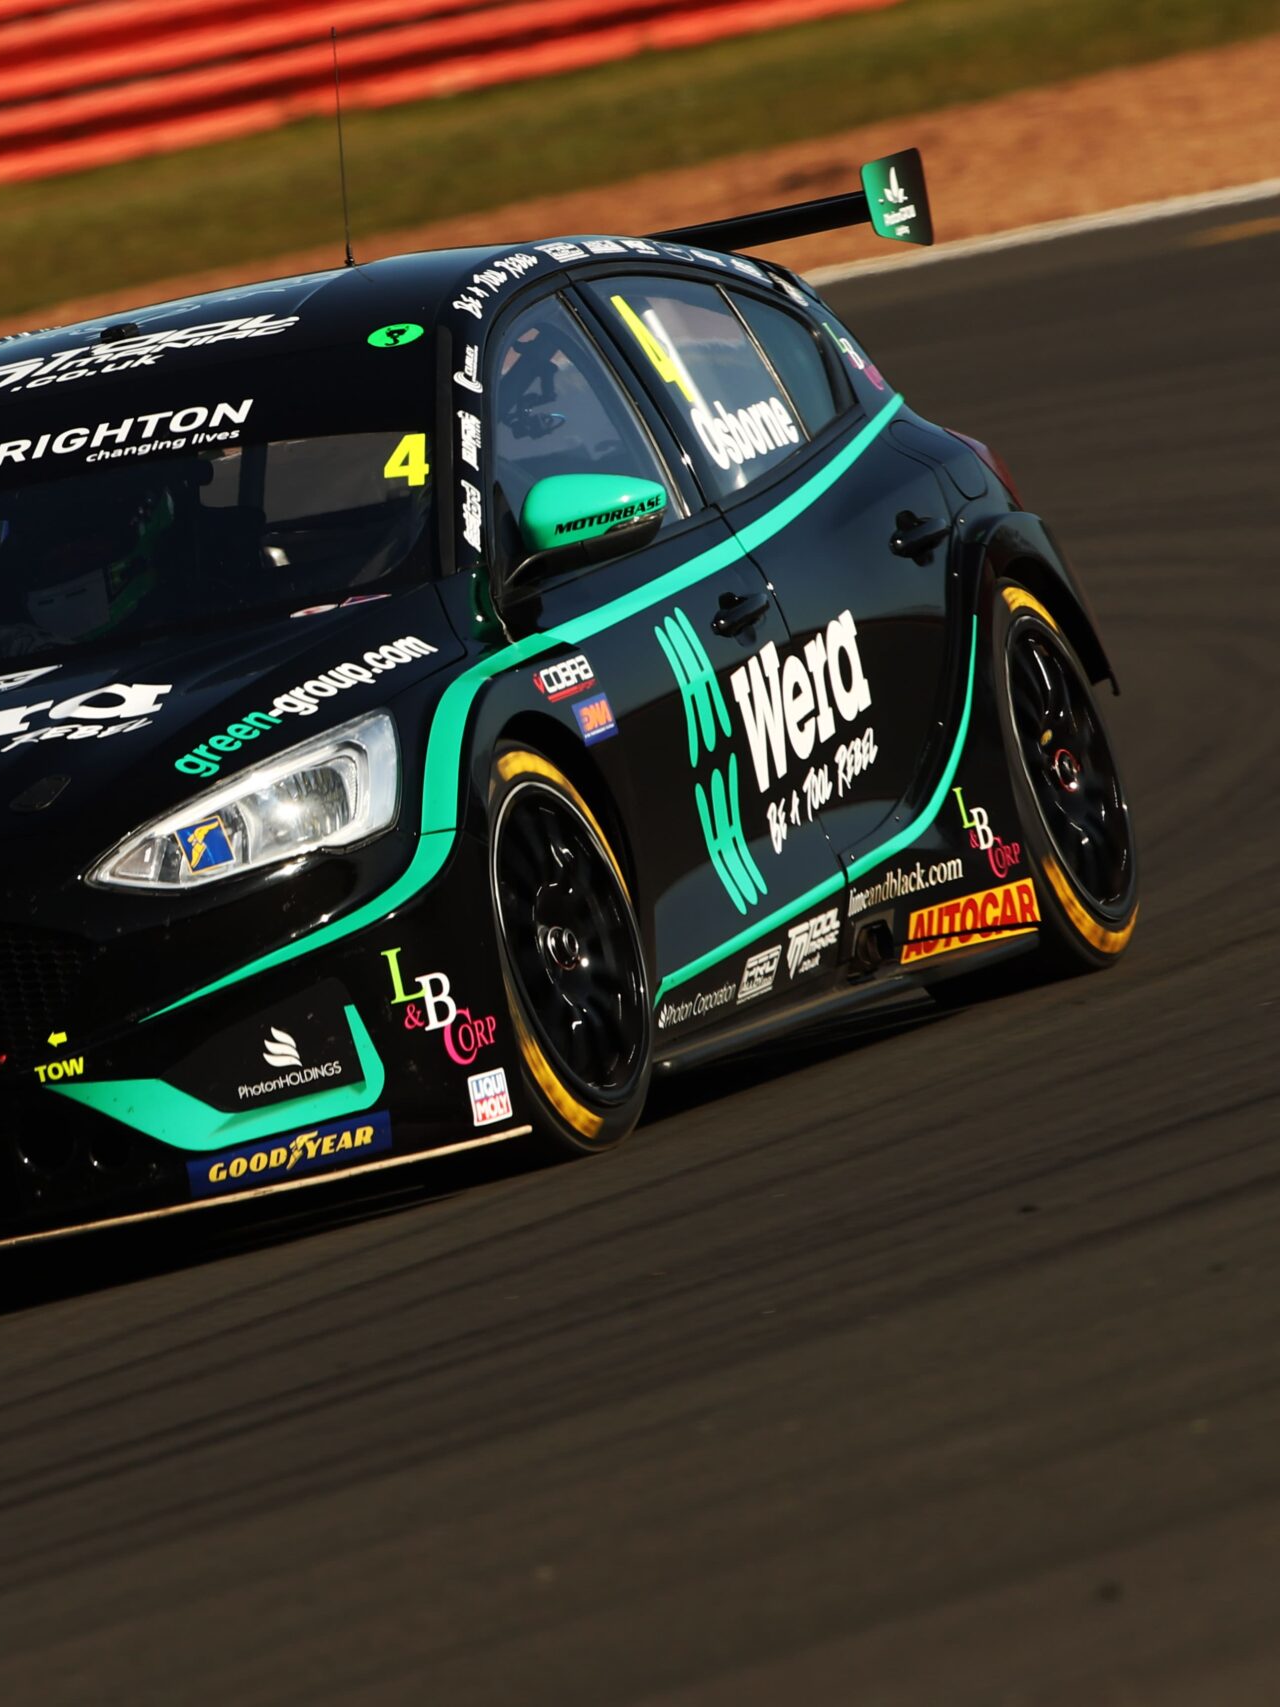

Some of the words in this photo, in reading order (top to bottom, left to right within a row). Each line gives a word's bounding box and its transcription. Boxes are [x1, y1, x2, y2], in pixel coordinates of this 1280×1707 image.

[609, 295, 696, 403] 4
[85, 437, 187, 464] changing
[190, 428, 242, 446] lives
[690, 397, 800, 470] Osborne
[383, 433, 430, 487] 4
[554, 494, 662, 536] MOTORBASE
[539, 654, 595, 694] COBRA
[174, 635, 440, 778] green-group.com
[729, 609, 873, 794] Wera
[1, 717, 154, 753] REBEL
[767, 798, 788, 855] BE
[790, 789, 802, 826] A
[803, 764, 834, 822] TOOL
[834, 727, 879, 797] REBEL
[847, 858, 964, 918] limeandblack.com
[903, 882, 1038, 960] AUTOCAR
[33, 1055, 84, 1083] TOW
[237, 1060, 342, 1100] PhotonHOLDINGS
[471, 1073, 506, 1101] LIQUI
[475, 1095, 510, 1123] MOLY
